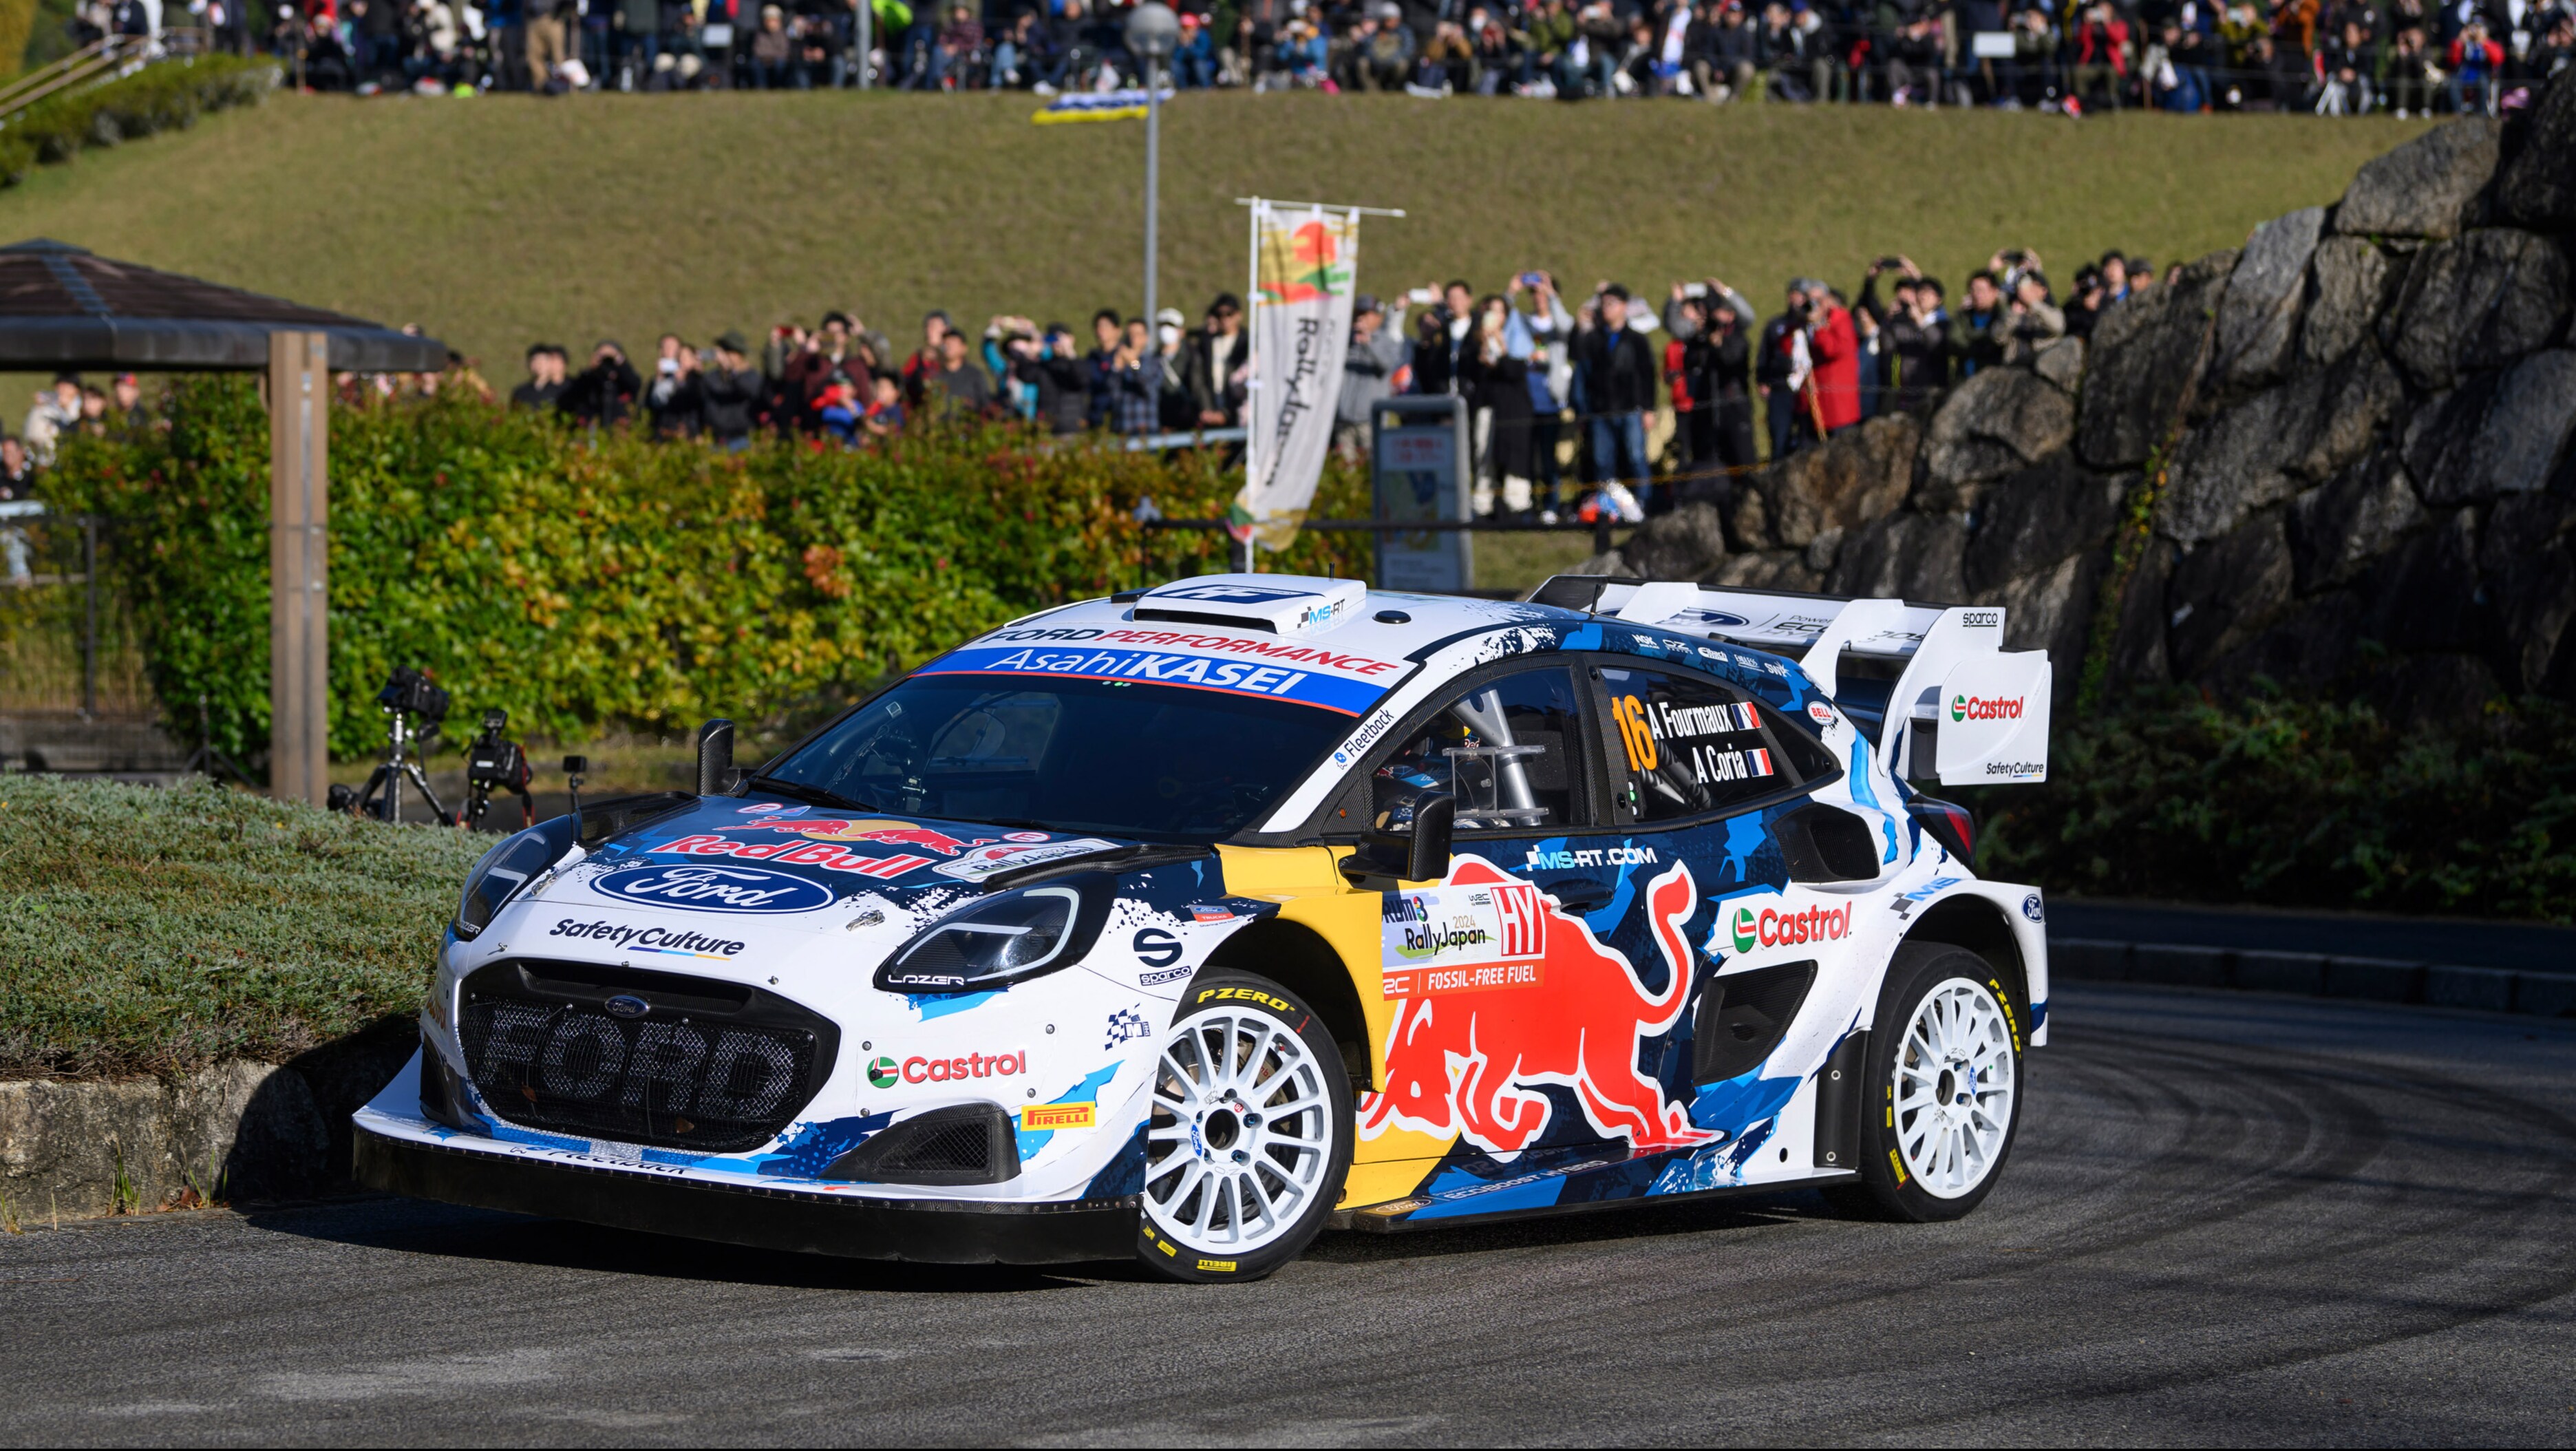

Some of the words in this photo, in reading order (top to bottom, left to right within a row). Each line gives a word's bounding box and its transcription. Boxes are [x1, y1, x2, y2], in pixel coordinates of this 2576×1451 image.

[1962, 611, 1998, 628] sparco
[1632, 634, 1657, 646] NGK
[980, 628, 1106, 644] FORD
[1094, 629, 1398, 677] PERFORMANCE
[1734, 654, 1759, 666] ENDLESS
[1811, 707, 1832, 718] BELL
[1967, 696, 2024, 720] Castrol
[1650, 703, 1664, 740] A
[1667, 702, 1735, 739] Fourmaux
[1343, 708, 1395, 759] Fleetback
[1612, 695, 1657, 772] 16
[1695, 752, 1709, 785] A
[1711, 743, 1747, 783] Coria
[654, 835, 795, 865] Red
[786, 840, 937, 879] Bull
[624, 866, 799, 909] Ford
[2027, 897, 2043, 918] Ford
[1453, 915, 1476, 929] 2024
[1492, 887, 1535, 955] HY
[1759, 901, 1852, 947] Castrol
[888, 974, 965, 986] LAZER
[1140, 966, 1191, 985] sparco
[1383, 976, 1410, 995] RC
[1428, 967, 1504, 990] FOSSIL-FREE
[1507, 965, 1536, 984] FUEL
[612, 999, 638, 1014] Ford
[477, 1004, 796, 1119] FORD
[902, 1050, 1027, 1083] Castrol
[1028, 1105, 1089, 1127] PIRELLI
[1191, 1129, 1202, 1152] Ford
[1444, 1174, 1542, 1199] ECOBOOST
[1540, 1160, 1609, 1177] HYBRID
[1197, 1259, 1237, 1272] PIRELLI
